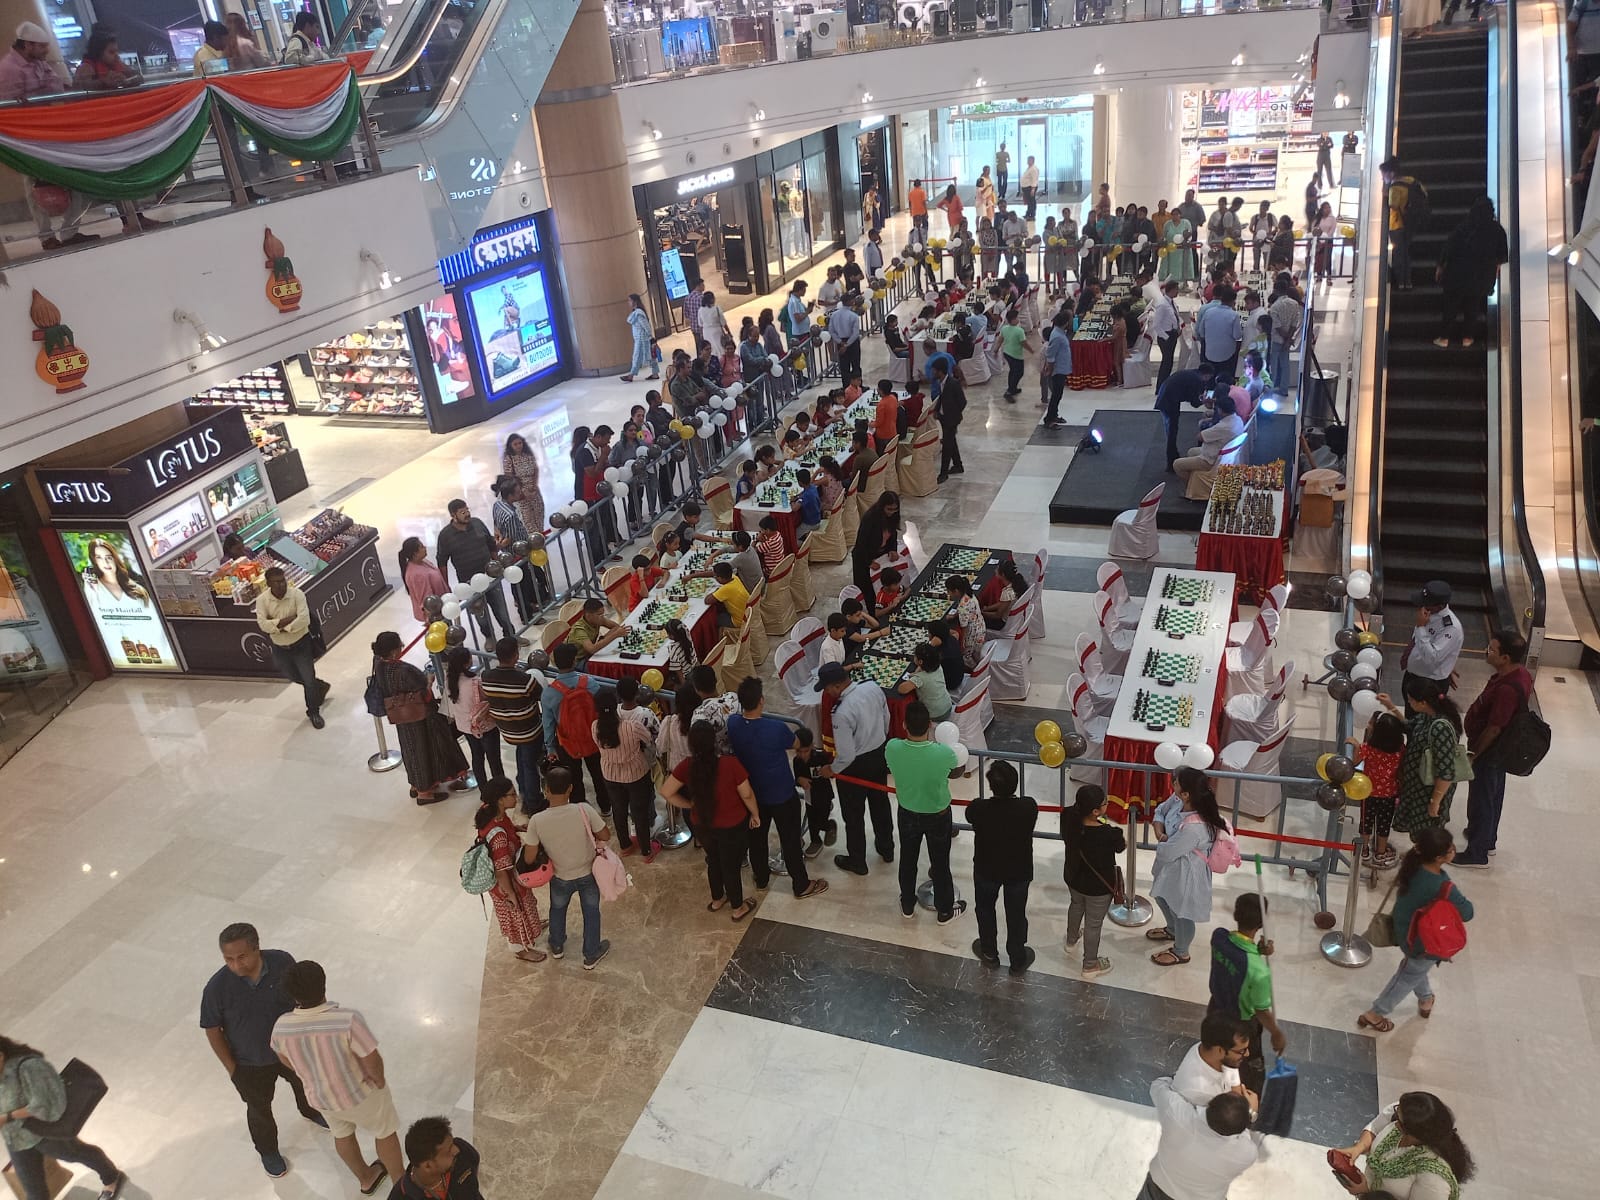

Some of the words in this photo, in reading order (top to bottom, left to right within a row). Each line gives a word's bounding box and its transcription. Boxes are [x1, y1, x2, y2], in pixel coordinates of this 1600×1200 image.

[146, 428, 222, 488] LOTUS
[46, 482, 112, 503] LOTUS
[315, 582, 356, 626] LOTUS
